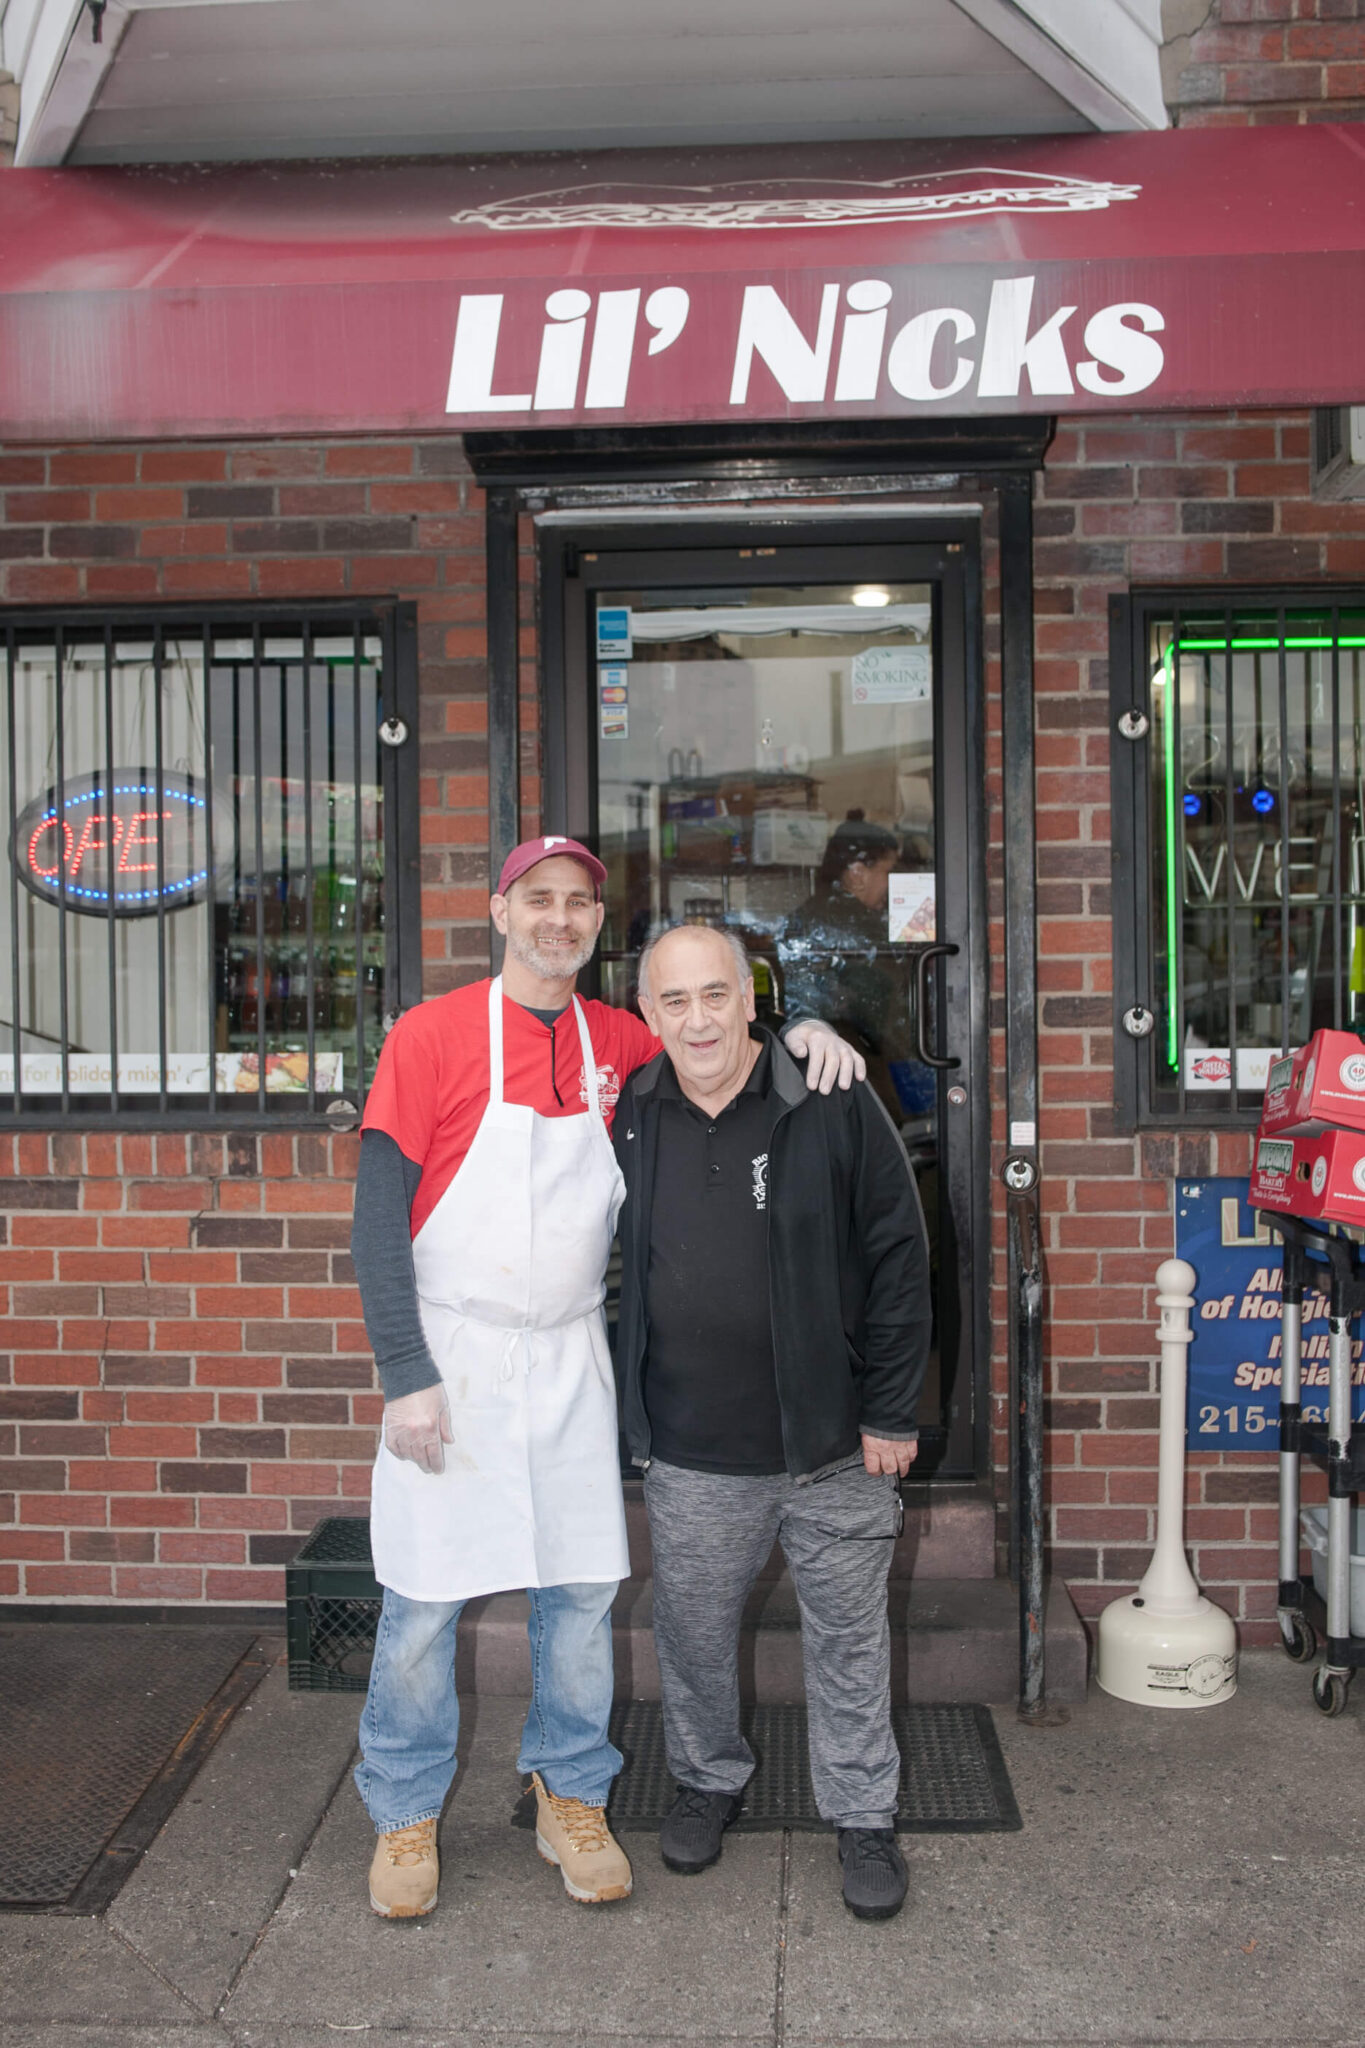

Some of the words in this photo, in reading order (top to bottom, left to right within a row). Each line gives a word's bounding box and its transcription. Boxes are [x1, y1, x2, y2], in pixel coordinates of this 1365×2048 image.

[729, 275, 1166, 404] Nicks
[855, 654, 880, 669] NO
[855, 670, 928, 685] SMOKING
[25, 1065, 48, 1082] for
[128, 1065, 182, 1082] mixn'
[1200, 1294, 1236, 1319] of
